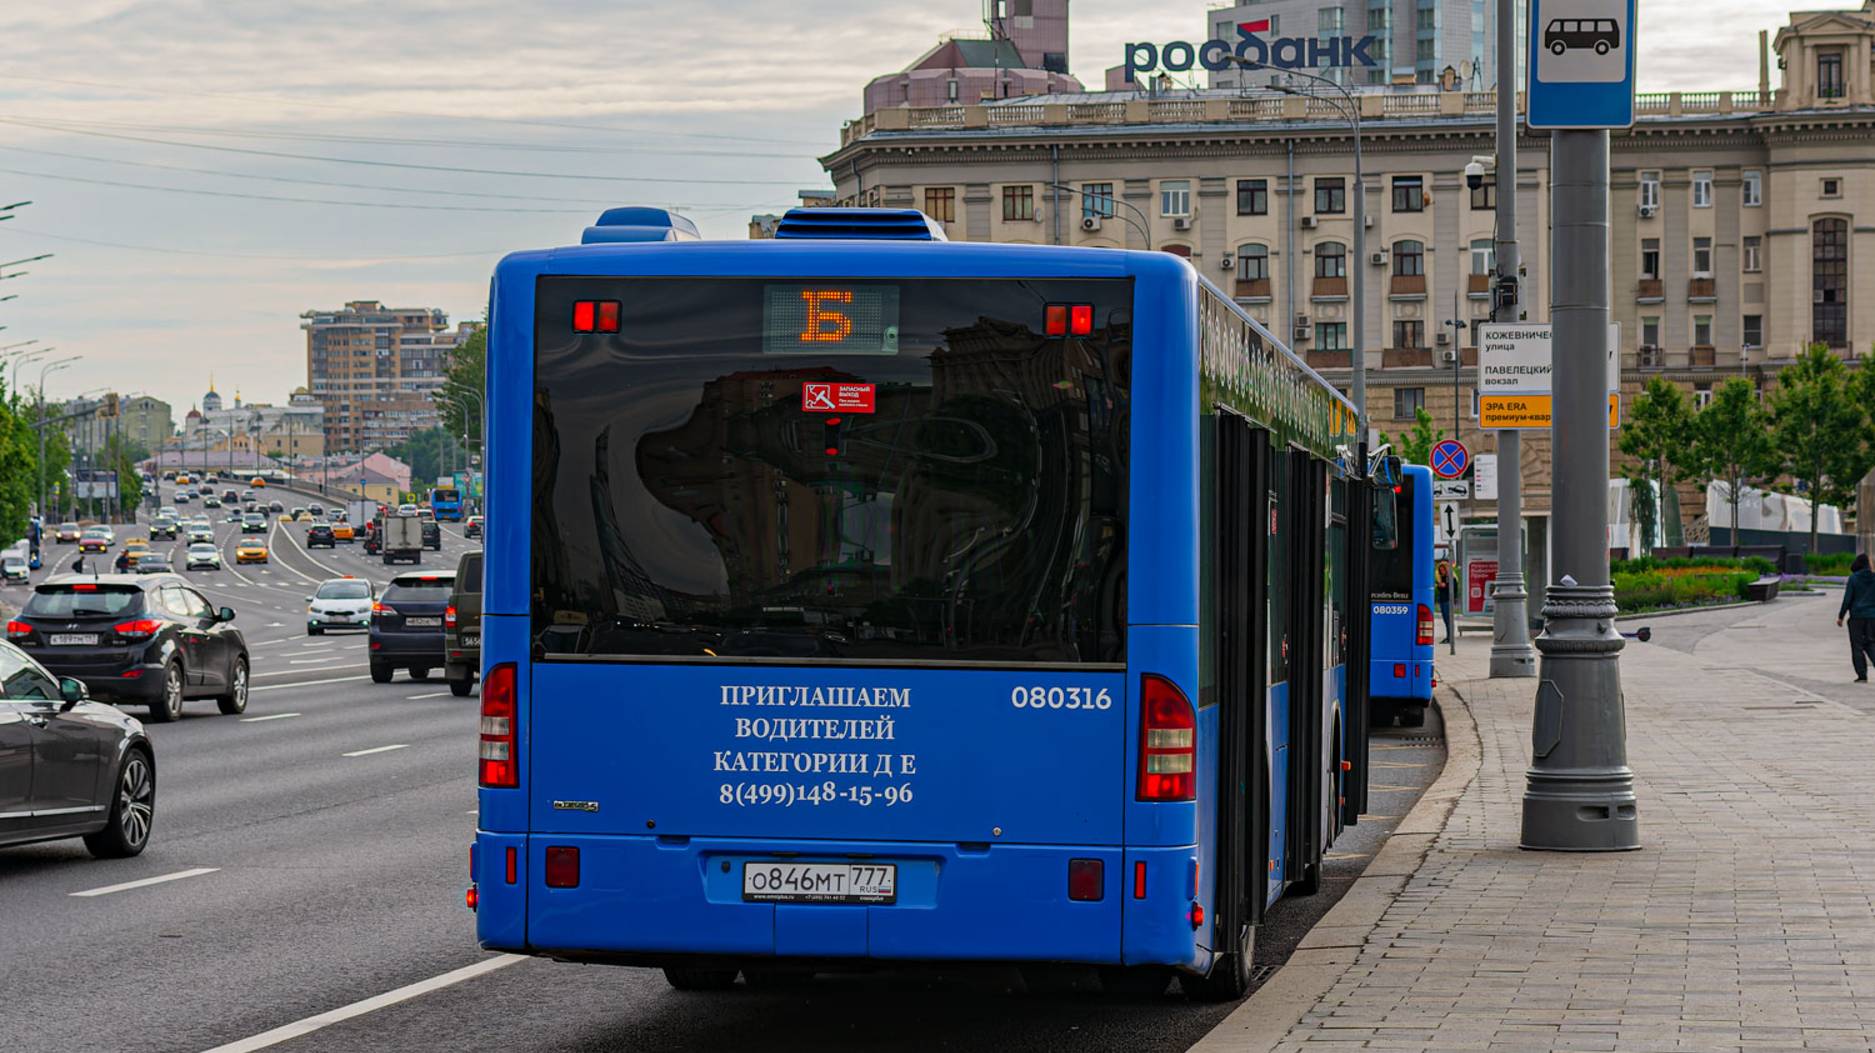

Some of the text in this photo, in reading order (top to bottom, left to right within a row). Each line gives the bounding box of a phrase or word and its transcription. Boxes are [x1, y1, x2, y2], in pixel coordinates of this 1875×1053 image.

[1125, 19, 1377, 83] росбанк
[801, 290, 852, 341] Б
[1485, 342, 1515, 352] улица
[1485, 378, 1518, 386] вокзал
[1485, 402, 1527, 411] ЭРА ERA
[1485, 413, 1552, 423] премиум-квар
[1373, 605, 1409, 615] 080359
[719, 685, 911, 708] ПРИГЛАШАЕМ
[1010, 686, 1113, 711] 080316
[735, 715, 896, 742] ВОДИТЕЛЕЙ
[713, 750, 916, 778] КАТЕГОРИИ Д Е
[719, 781, 914, 807] 8(499)148-15-96
[852, 867, 888, 886] 777
[859, 885, 877, 894] RUS
